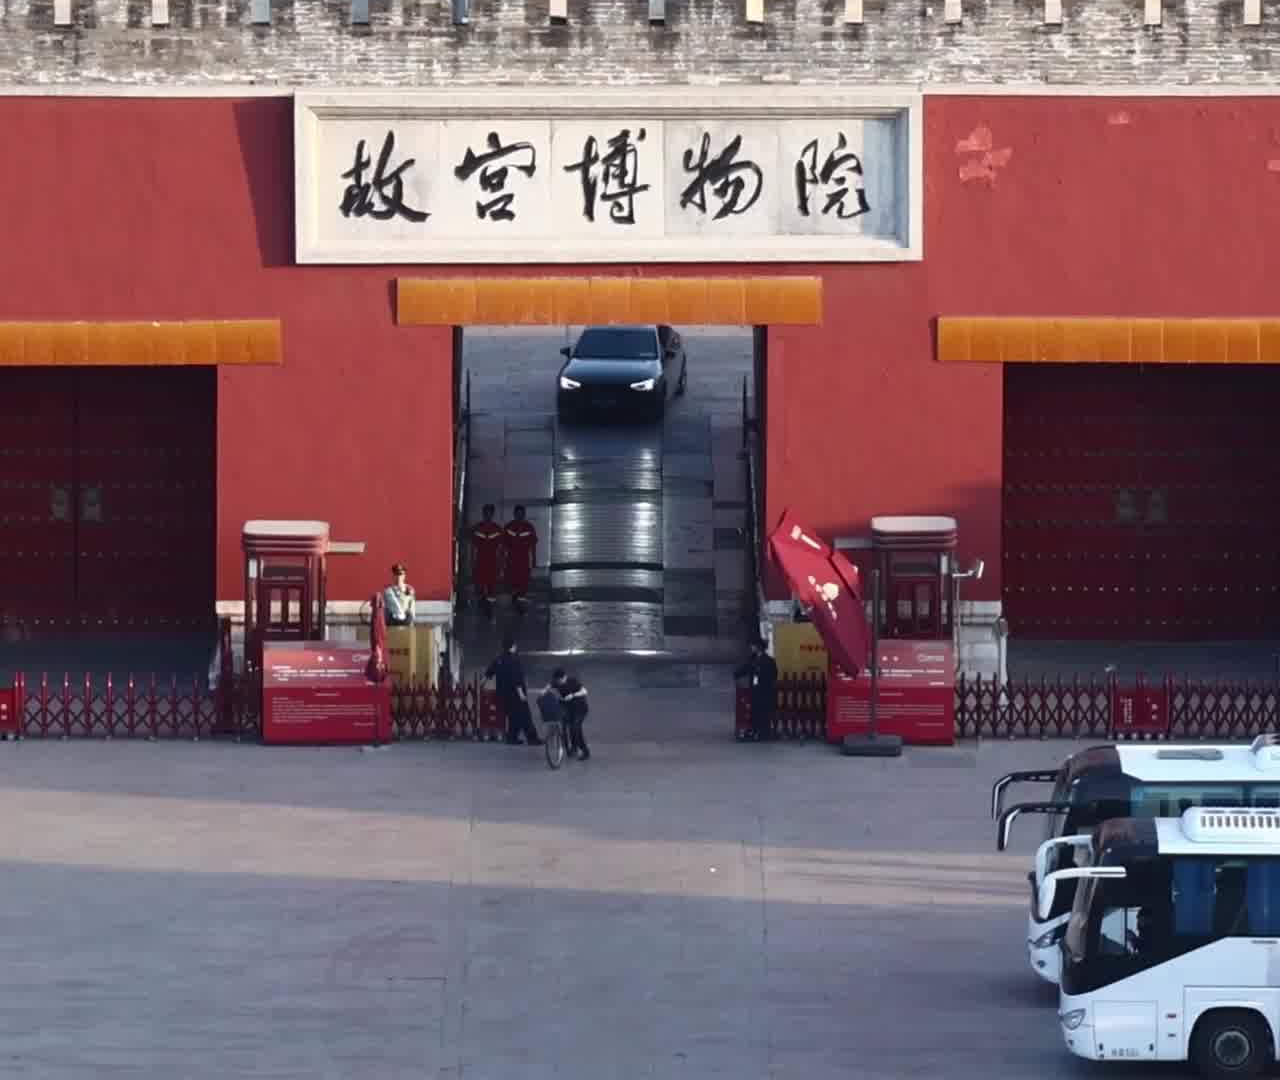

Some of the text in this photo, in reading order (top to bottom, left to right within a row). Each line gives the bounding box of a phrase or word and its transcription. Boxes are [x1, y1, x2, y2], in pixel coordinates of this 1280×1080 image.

[338, 128, 872, 225] 故宫博物院
